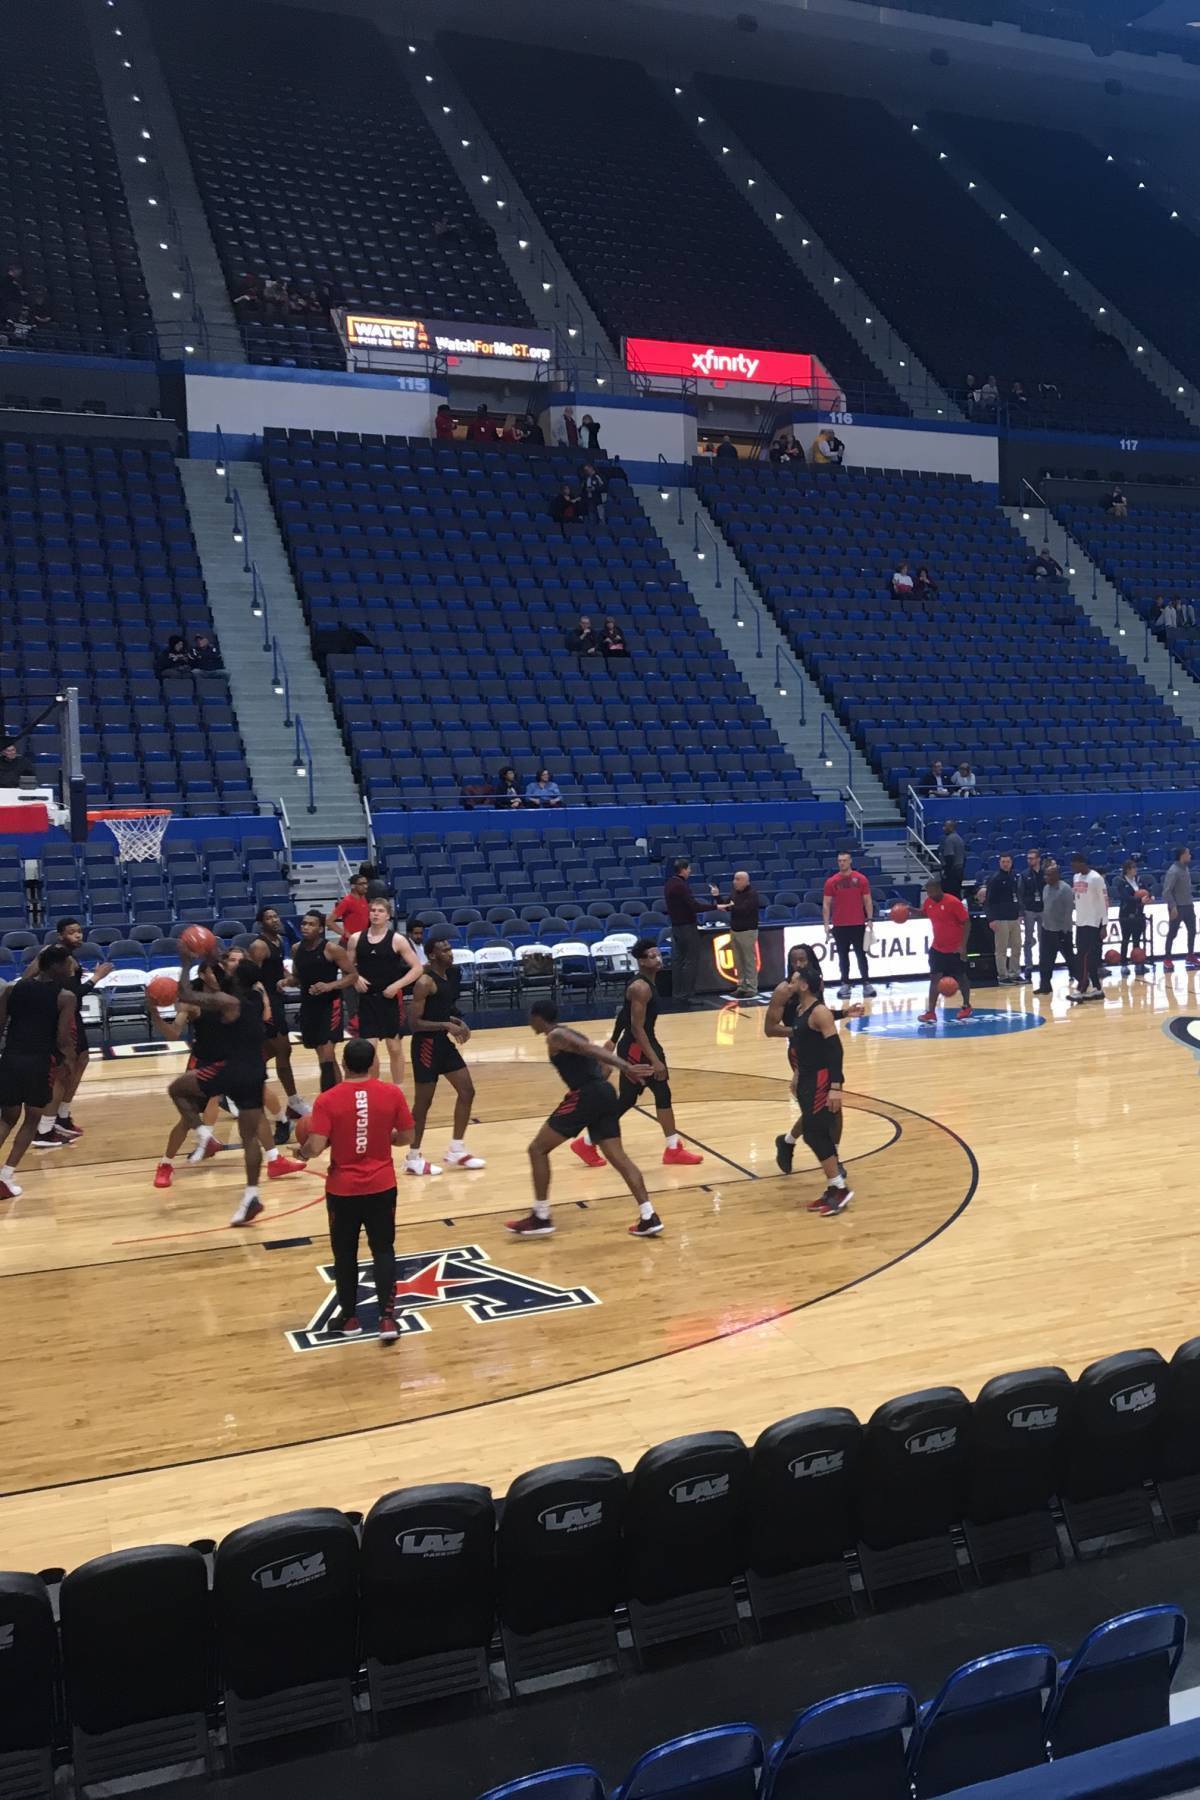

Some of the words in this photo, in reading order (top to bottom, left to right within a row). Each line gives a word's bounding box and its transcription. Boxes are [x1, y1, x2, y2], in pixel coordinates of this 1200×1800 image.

[354, 322, 415, 339] WATCH
[435, 336, 550, 361] WatchForMeCT.org
[692, 349, 759, 378] xfinity
[398, 377, 428, 391] 115
[829, 412, 853, 424] 116
[1119, 439, 1138, 450] 117
[811, 936, 917, 962] OFCIAL
[355, 1090, 368, 1154] COUGARS
[1116, 1383, 1156, 1412] LAZ
[1011, 1406, 1058, 1428] LAZ
[910, 1426, 957, 1454] LAZ
[794, 1450, 844, 1478] LAZ
[675, 1474, 730, 1503] LAZ
[545, 1501, 602, 1531] LAZ
[402, 1531, 464, 1554] LAZ
[260, 1551, 327, 1589] LAZ
